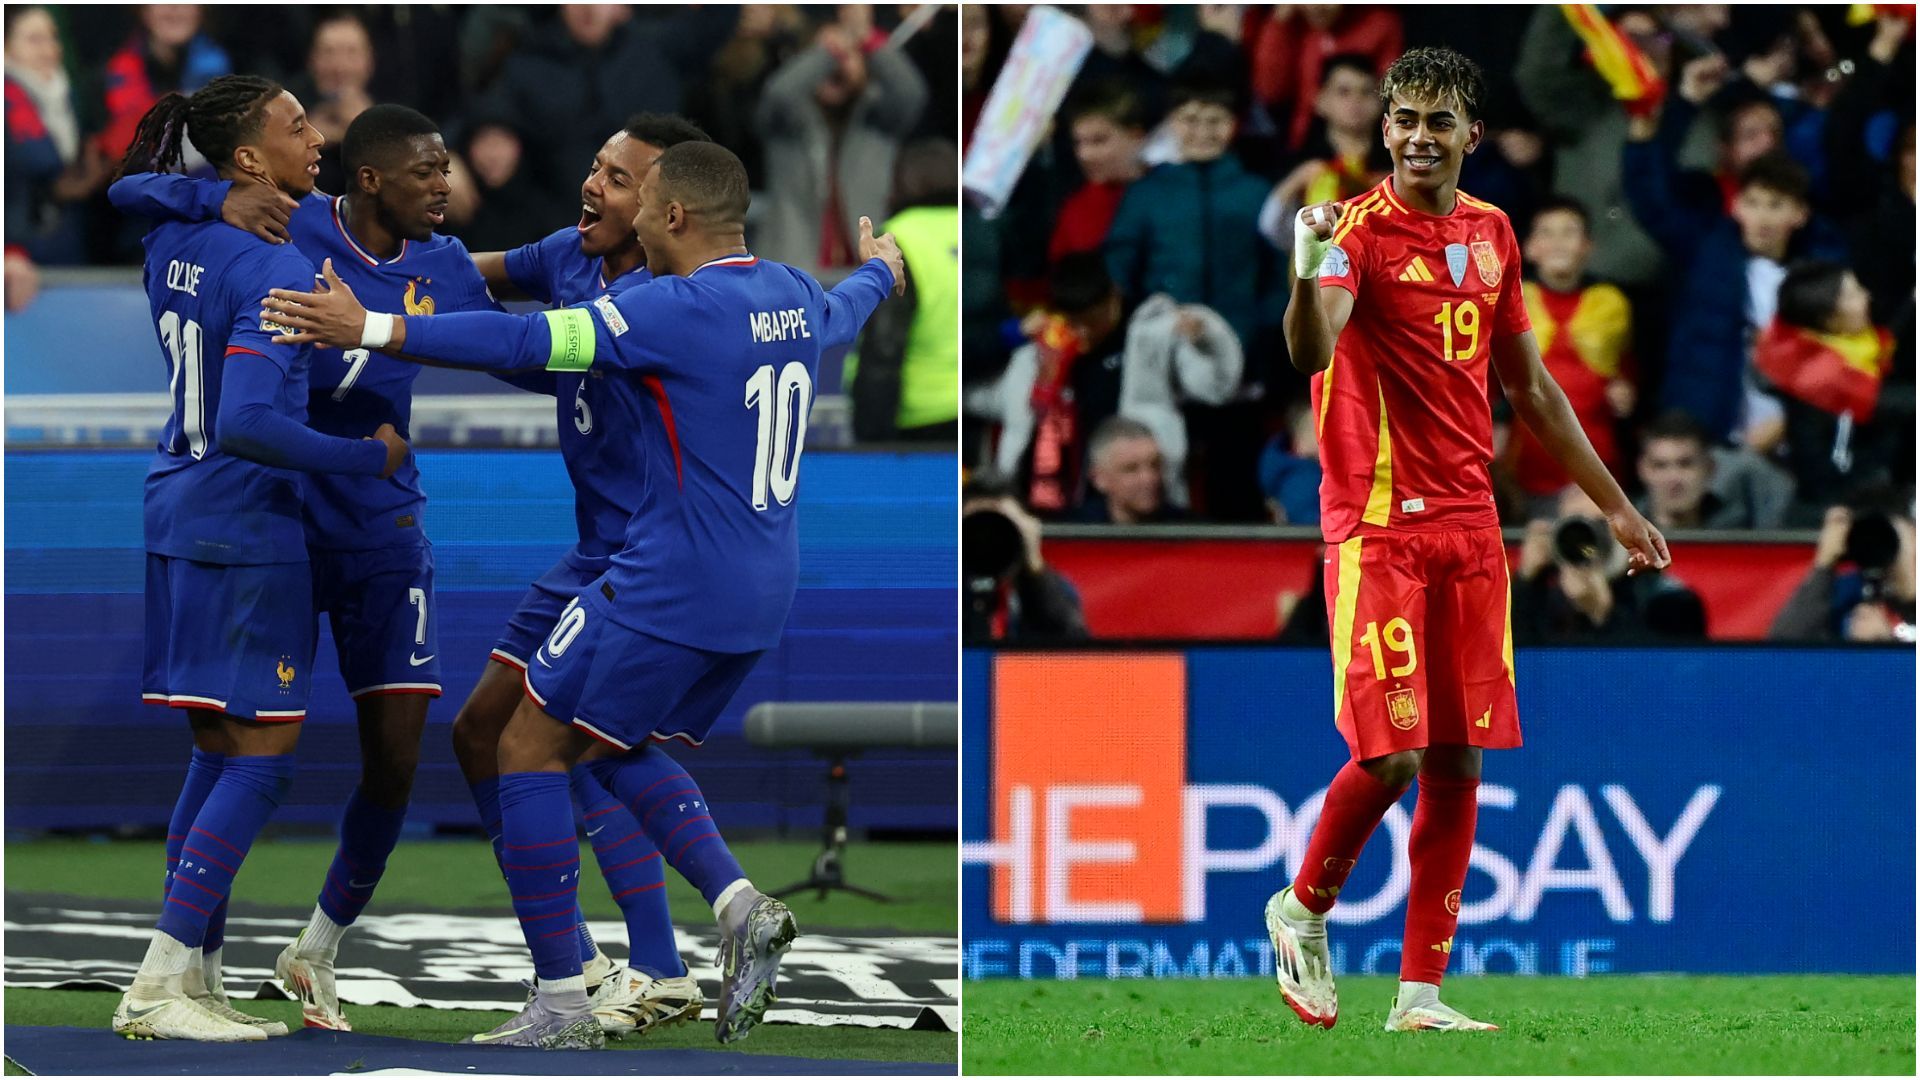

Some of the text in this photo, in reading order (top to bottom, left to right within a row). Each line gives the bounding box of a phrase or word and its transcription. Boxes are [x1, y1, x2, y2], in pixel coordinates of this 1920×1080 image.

[167, 259, 204, 297] OLISE
[567, 323, 578, 362] RESPECT
[750, 308, 811, 343] MBAPPE
[1434, 300, 1479, 361] 19
[159, 310, 207, 461] 11
[331, 348, 370, 402] 7
[574, 378, 593, 435] 5
[745, 361, 813, 511] 10
[409, 588, 428, 645] 7
[1360, 616, 1417, 680] 19
[1182, 784, 1724, 925] POSAY
